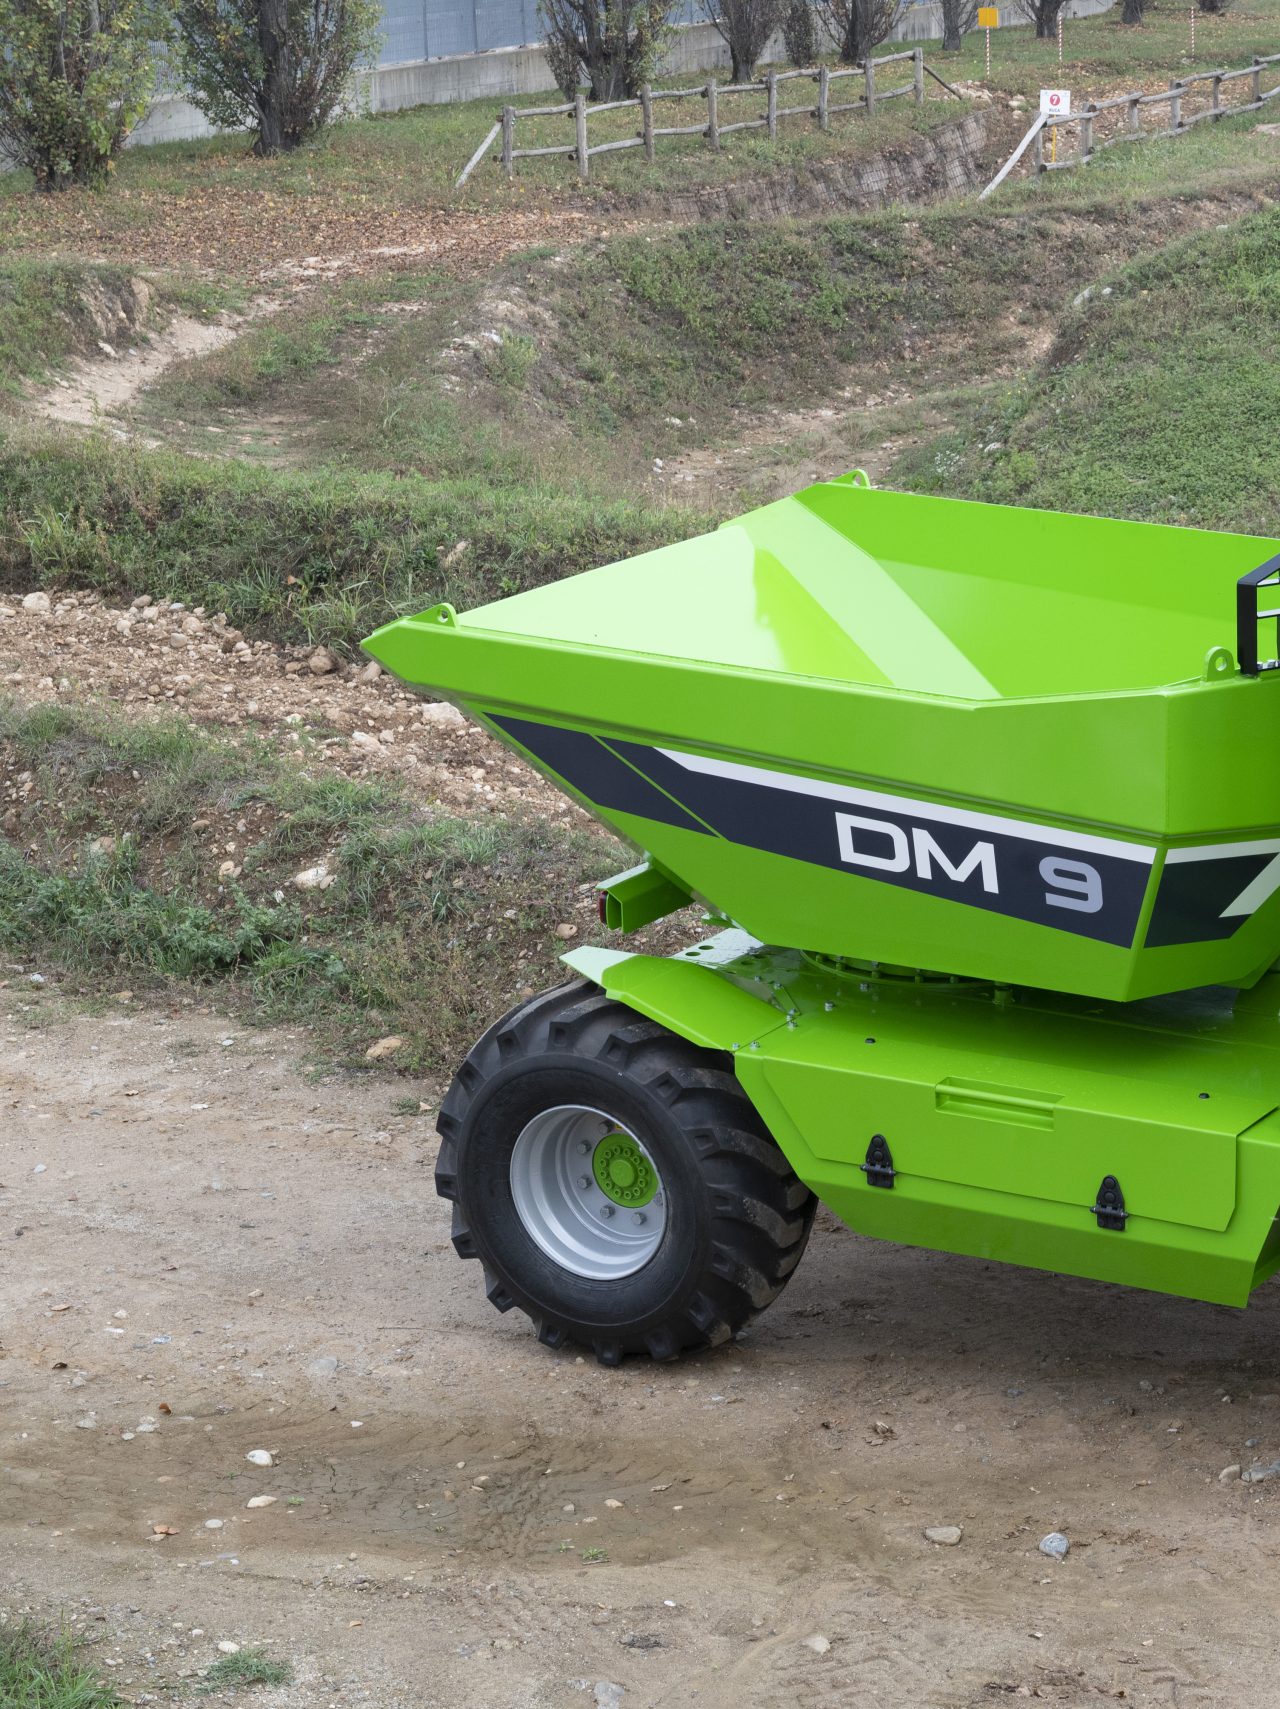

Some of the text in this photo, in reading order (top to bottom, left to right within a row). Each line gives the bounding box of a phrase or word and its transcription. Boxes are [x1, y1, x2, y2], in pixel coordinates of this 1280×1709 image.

[1052, 95, 1058, 105] 7
[834, 811, 1104, 914] DM 9
